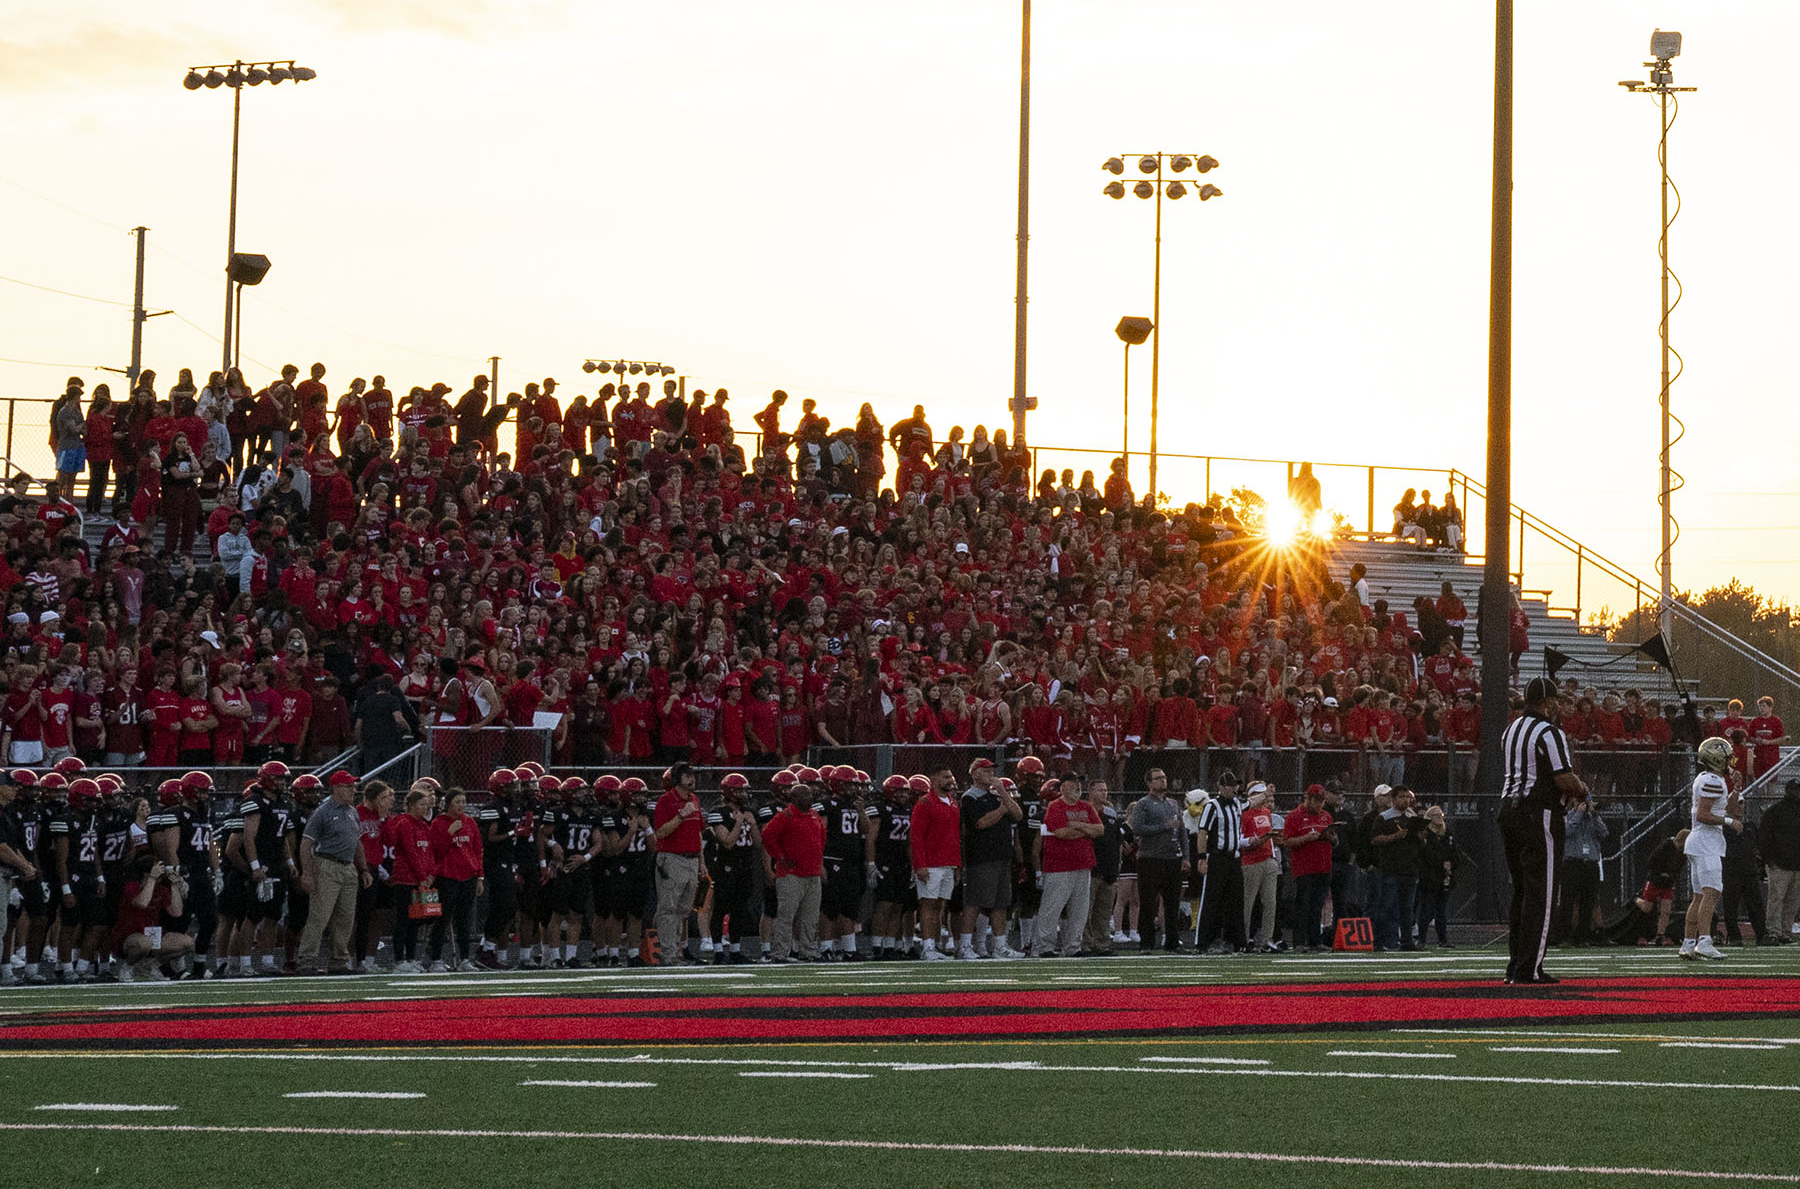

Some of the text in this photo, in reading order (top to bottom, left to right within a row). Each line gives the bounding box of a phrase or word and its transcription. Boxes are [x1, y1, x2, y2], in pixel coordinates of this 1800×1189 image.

[277, 813, 287, 837] 7
[841, 812, 859, 834] 67
[889, 818, 911, 841] 22
[103, 835, 127, 861] 27
[190, 825, 210, 851] 44
[567, 828, 590, 851] 18
[1342, 920, 1371, 946] 20
